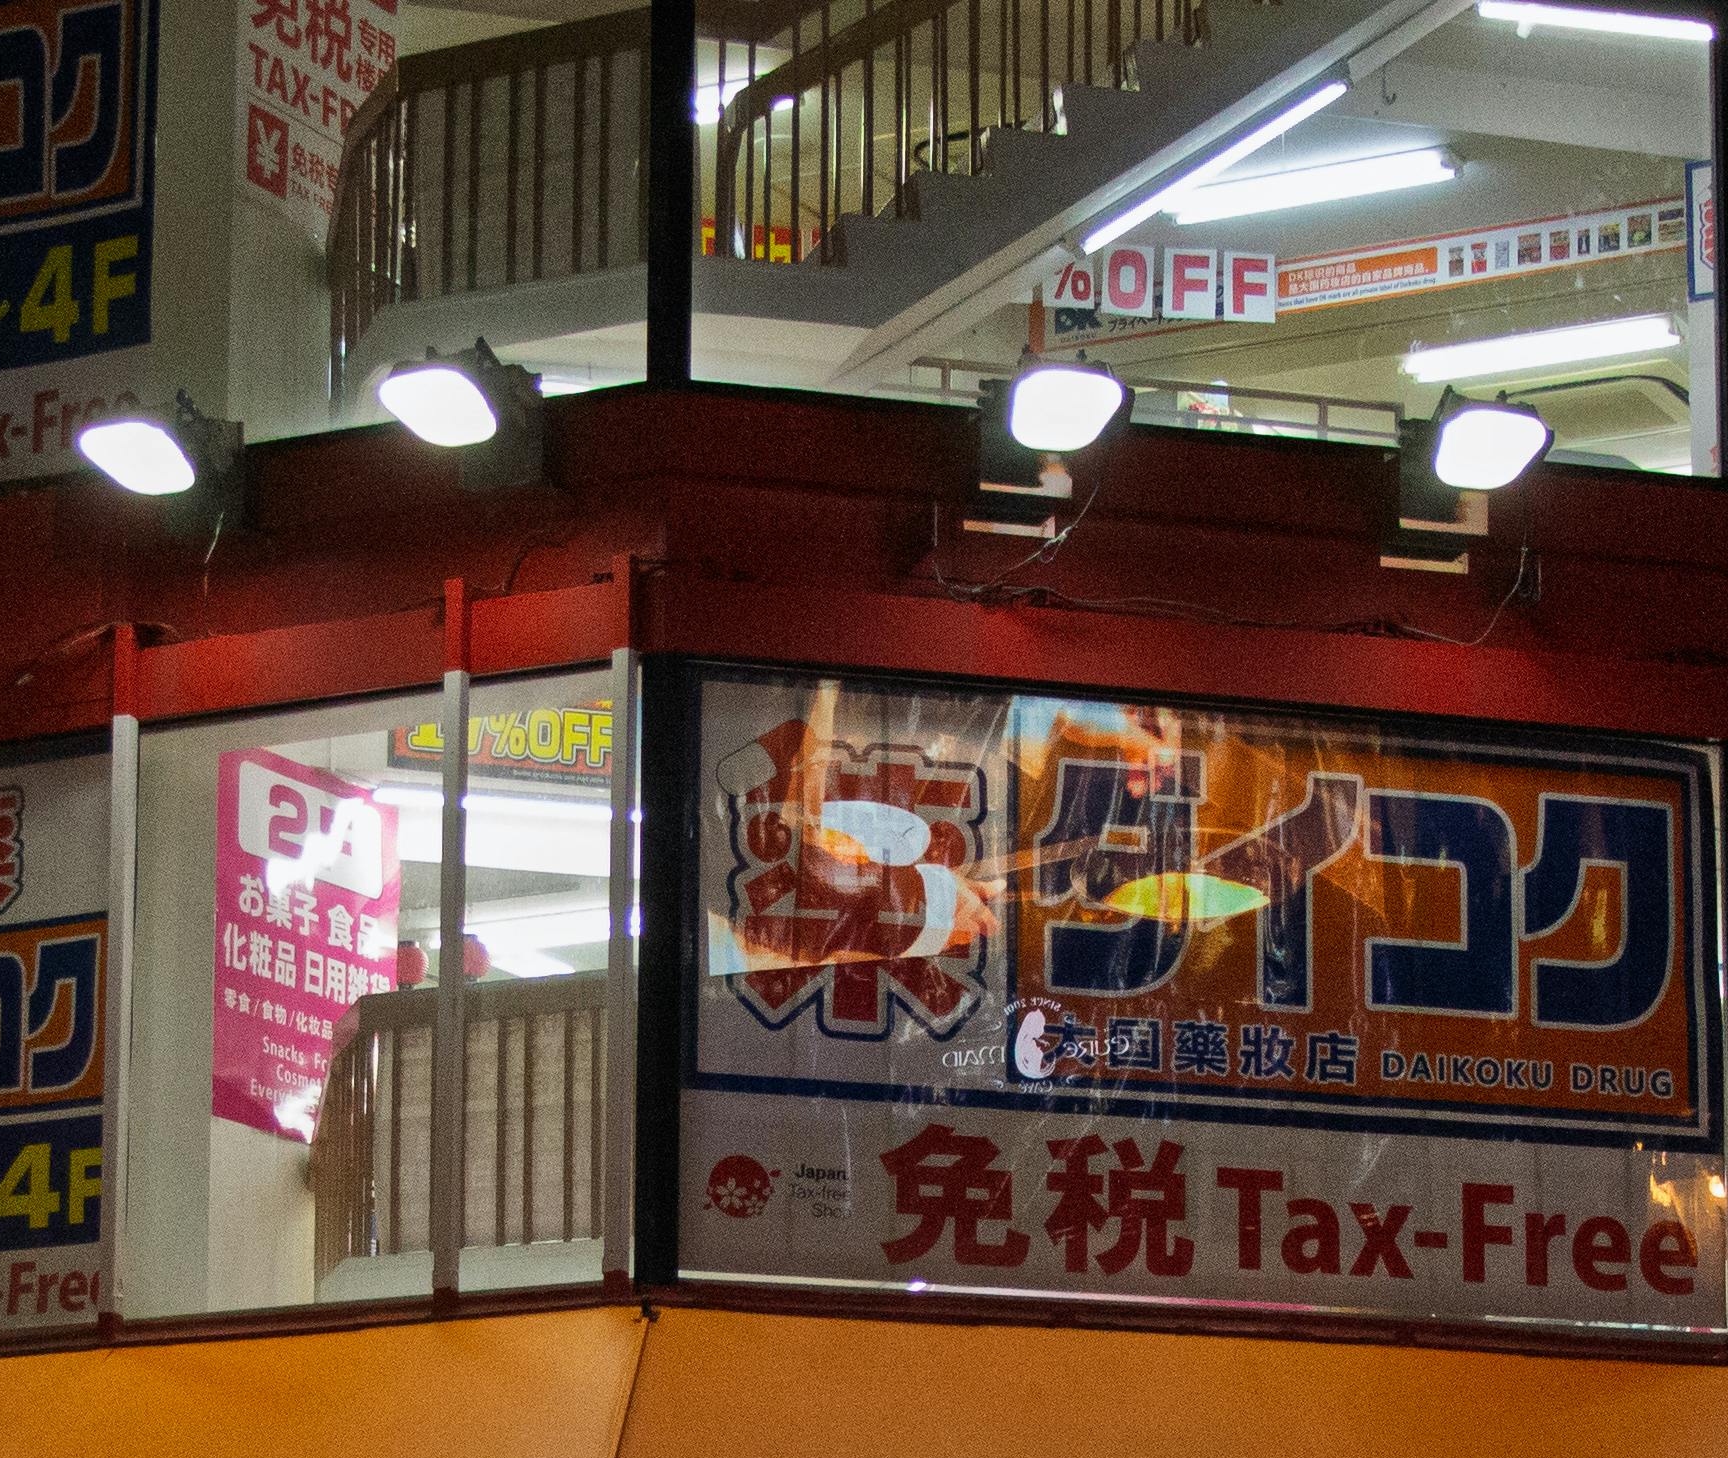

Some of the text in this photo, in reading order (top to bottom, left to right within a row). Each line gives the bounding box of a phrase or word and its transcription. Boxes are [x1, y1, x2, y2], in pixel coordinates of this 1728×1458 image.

[238, 873, 379, 962] お菓子 食品
[718, 722, 988, 1042] 薬
[1032, 746, 1675, 1030] ダイコク
[223, 922, 298, 989] 化粧品
[261, 1035, 305, 1066] Snacks
[1382, 1048, 1555, 1092] DAIKOKU
[1572, 1063, 1674, 1099] DRUG
[788, 1182, 851, 1203] Tax-free
[880, 1122, 1699, 1298] 免税 Tax-Free
